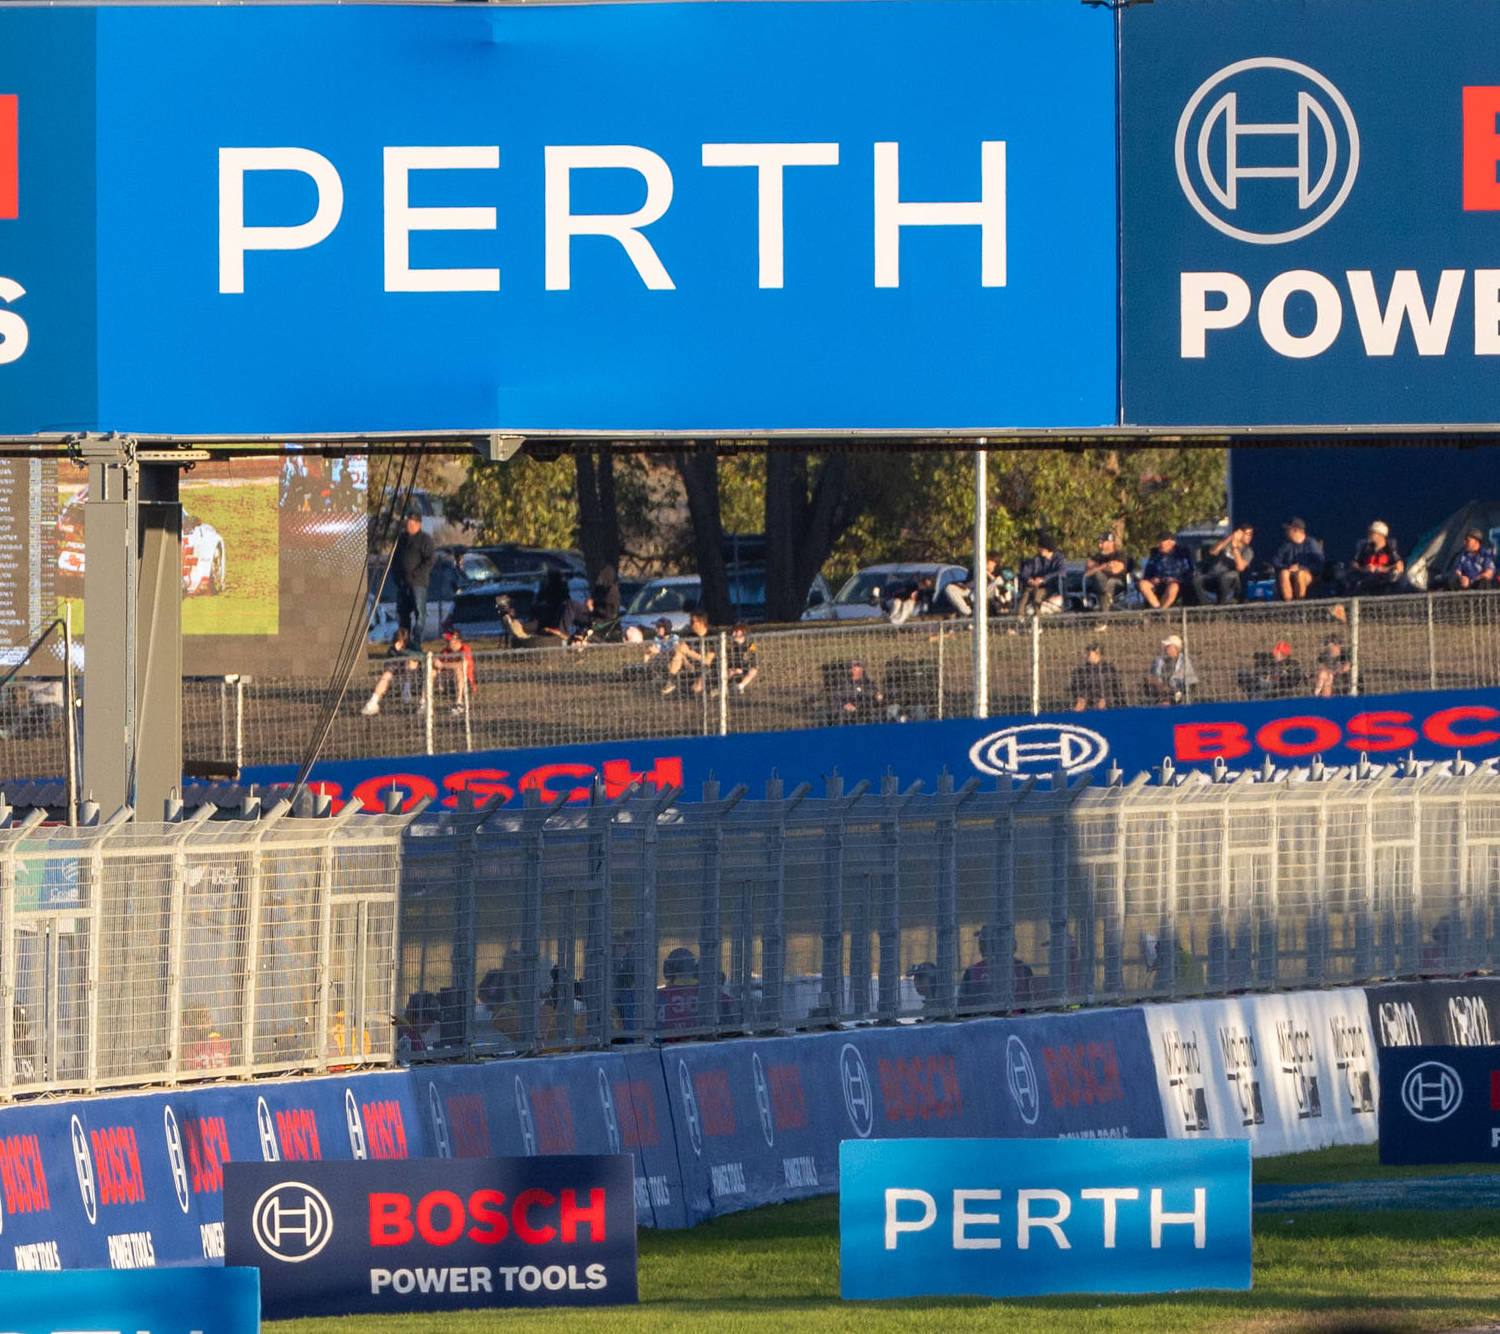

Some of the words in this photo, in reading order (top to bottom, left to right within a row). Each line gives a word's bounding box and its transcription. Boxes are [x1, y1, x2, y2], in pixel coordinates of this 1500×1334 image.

[220, 142, 1007, 294] PERTH
[877, 1055, 963, 1122] BOSCH
[1041, 1041, 1125, 1109] BOSCH
[185, 1116, 228, 1196] BOSCH
[277, 1111, 322, 1161] BOSCH
[364, 1103, 408, 1159] BOSCH
[92, 1129, 145, 1205] BOSCH
[370, 1190, 606, 1247] BOSCH
[886, 1188, 1207, 1250] PERTH
[371, 1268, 492, 1294] POWER
[503, 1265, 608, 1292] TOOLS
